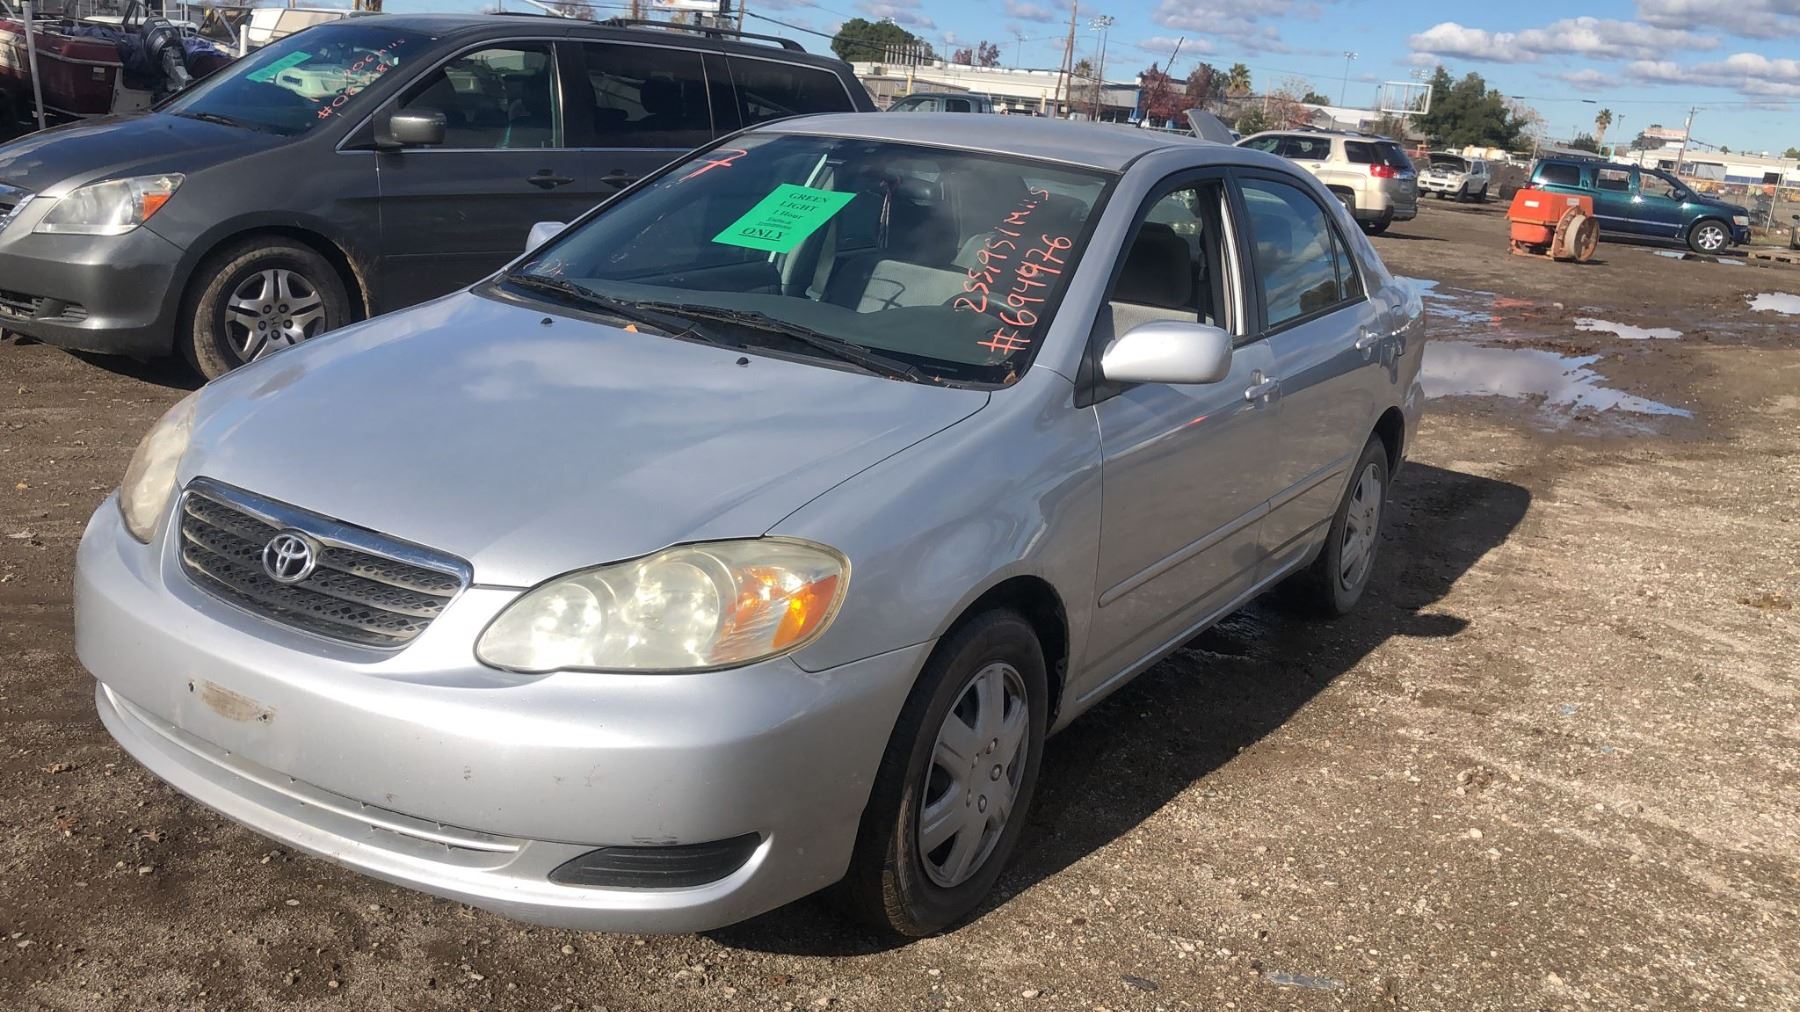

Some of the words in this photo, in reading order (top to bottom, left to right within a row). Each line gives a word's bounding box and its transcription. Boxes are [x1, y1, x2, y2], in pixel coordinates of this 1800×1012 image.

[788, 191, 829, 204] GREEN
[779, 200, 818, 213] LIGHT
[780, 209, 804, 220] Hour
[741, 227, 784, 241] ONLY
